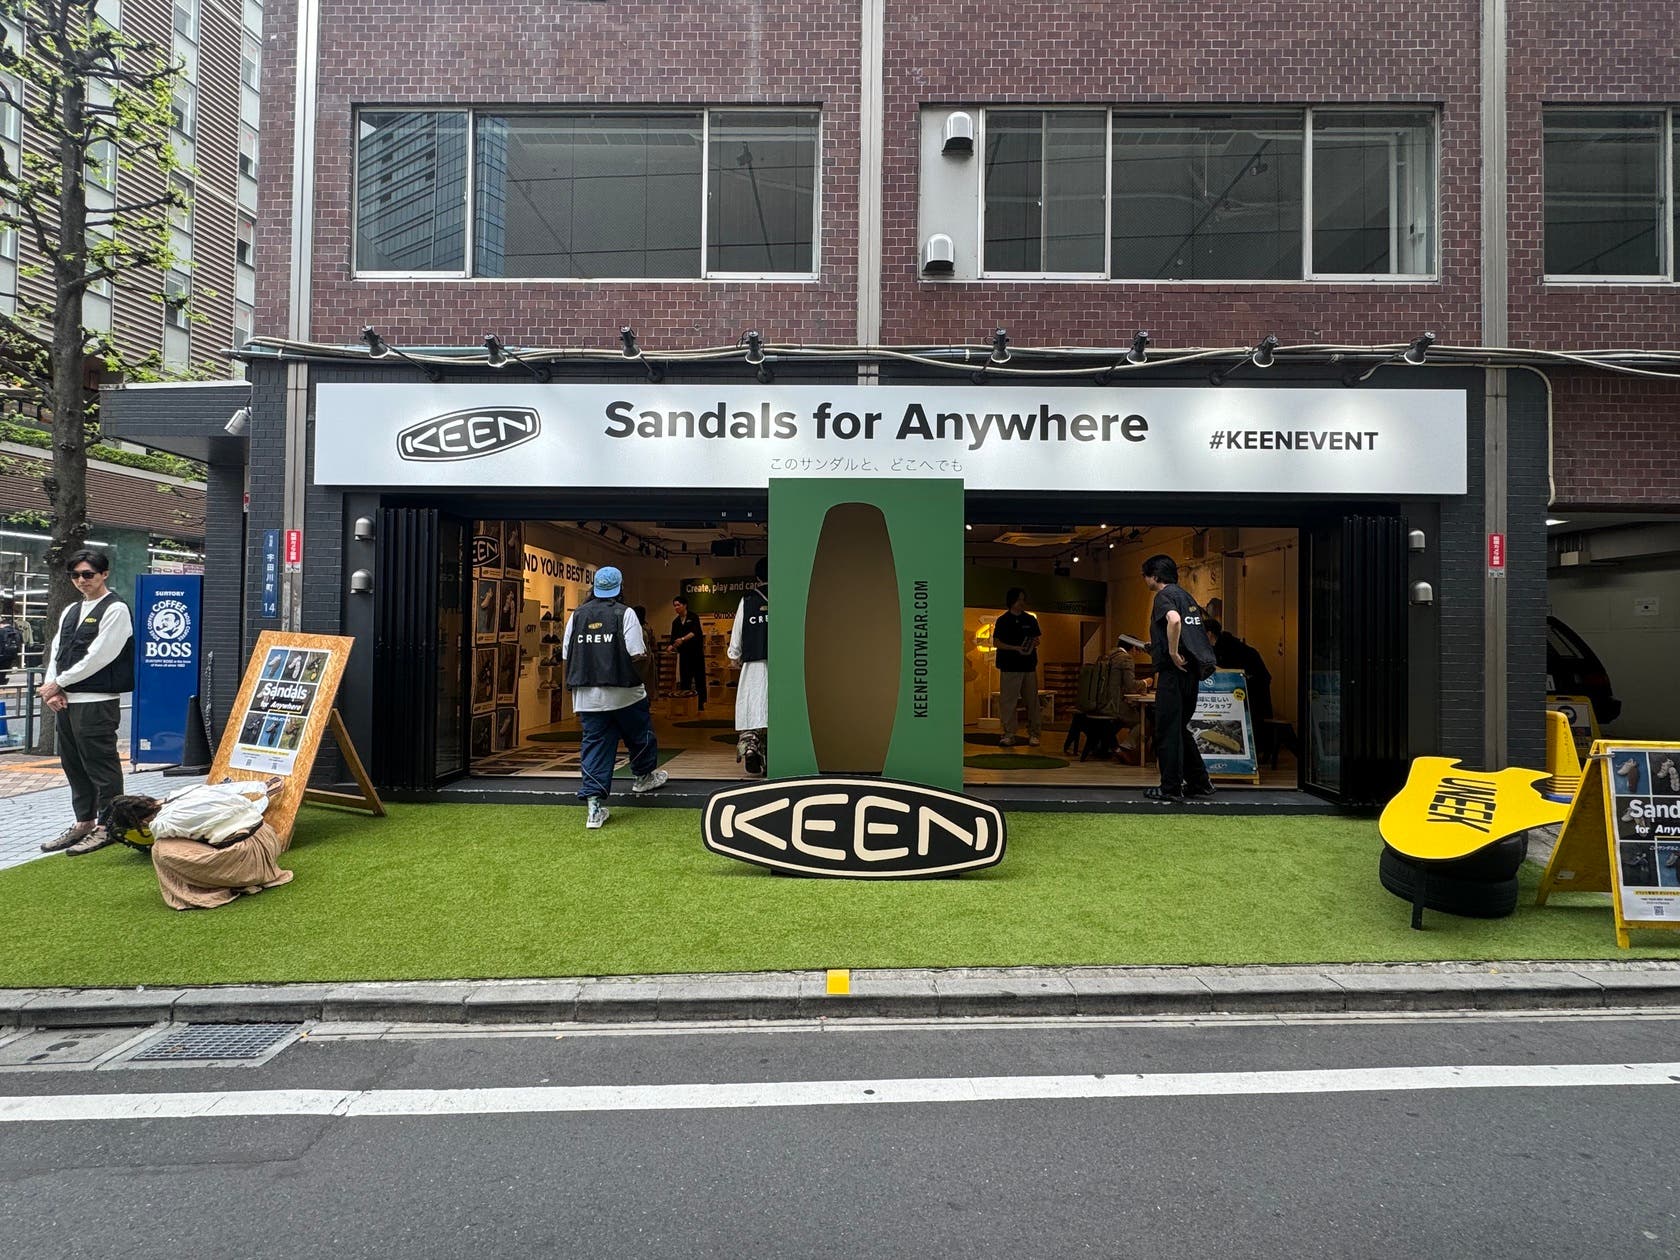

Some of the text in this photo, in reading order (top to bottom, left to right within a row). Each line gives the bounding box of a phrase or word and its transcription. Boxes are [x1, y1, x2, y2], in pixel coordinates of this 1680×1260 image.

[406, 415, 533, 451] KEEN
[605, 401, 1148, 450] Sandals for Anywhere
[1209, 431, 1379, 451] #KEENEVENT
[771, 457, 963, 472] このサンダルと、どこへでも
[266, 553, 275, 593] 宇田川町
[541, 557, 564, 579] YOUR
[566, 564, 584, 583] BEST
[686, 584, 711, 594] Create,
[712, 582, 728, 594] play
[730, 581, 744, 591] and
[152, 600, 188, 614] COFFEE
[263, 602, 276, 613] 14
[577, 633, 613, 644] CREW
[145, 641, 192, 658] BOSS
[914, 581, 928, 718] KEENFOOTWEAR.COM
[262, 682, 308, 700] Sandals
[270, 701, 302, 711] Anywhere
[1426, 777, 1498, 833] UNEEK
[1629, 799, 1680, 819] Sand
[720, 793, 989, 862] KEEN
[1635, 824, 1650, 834] for
